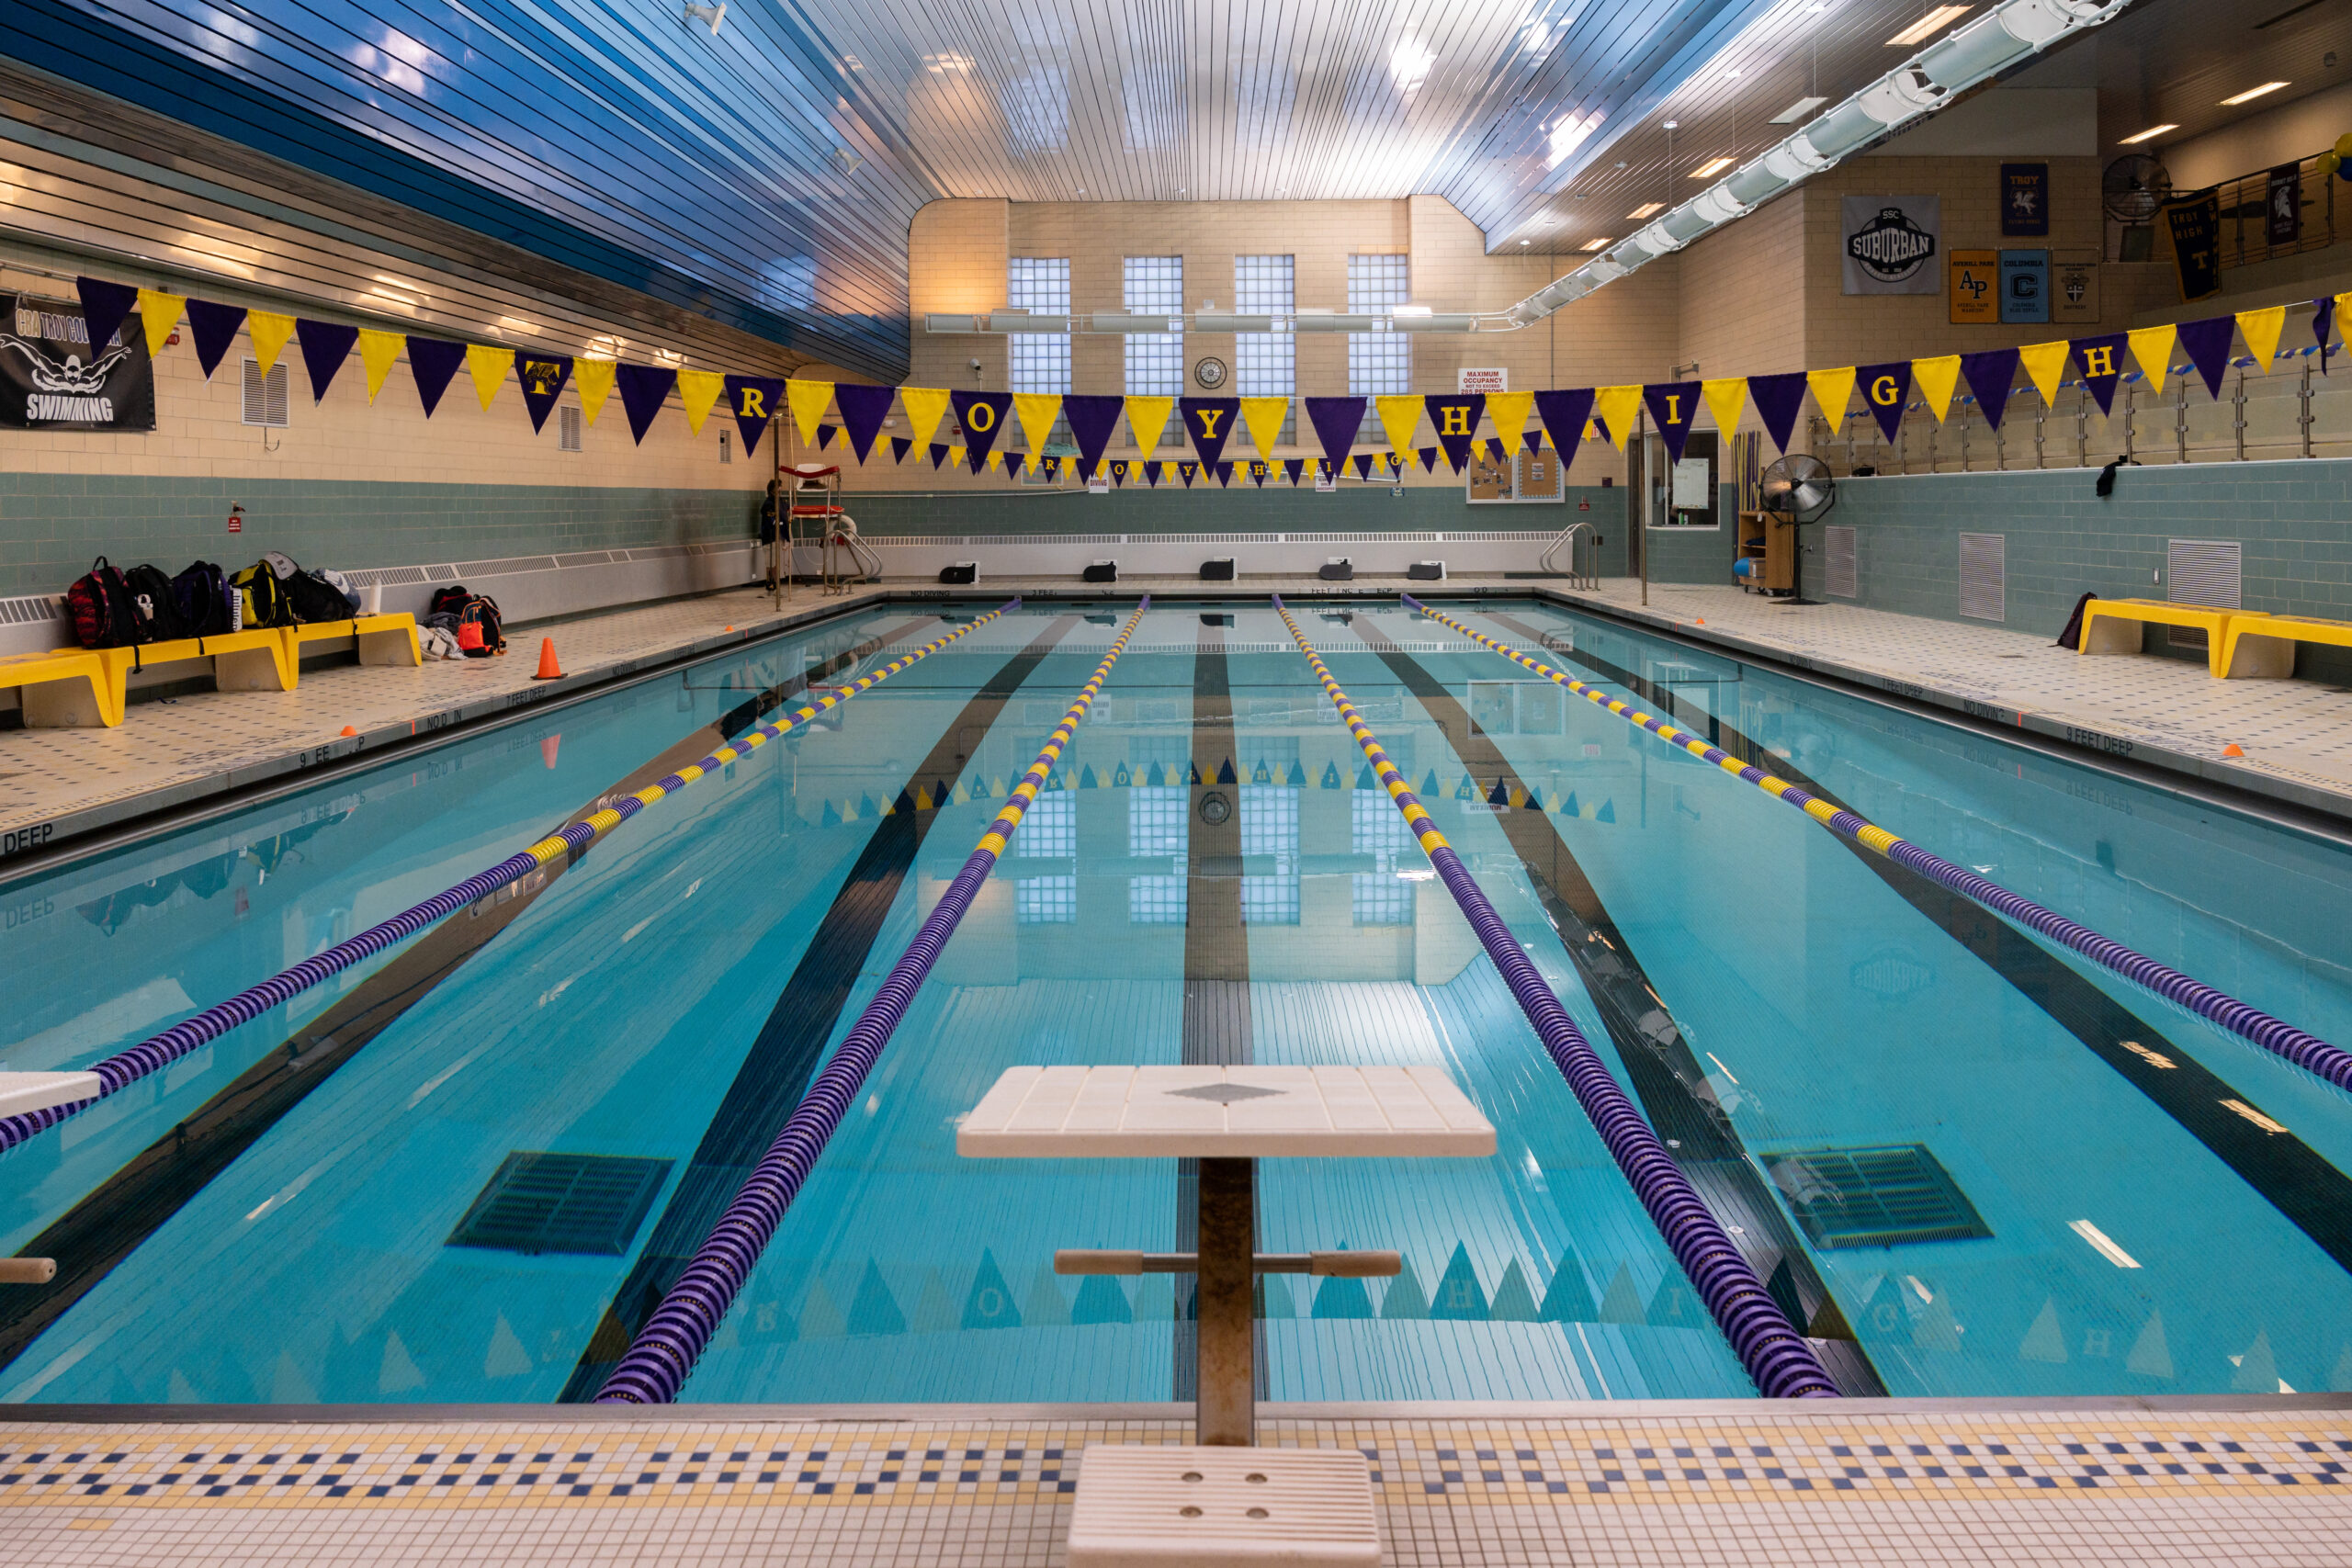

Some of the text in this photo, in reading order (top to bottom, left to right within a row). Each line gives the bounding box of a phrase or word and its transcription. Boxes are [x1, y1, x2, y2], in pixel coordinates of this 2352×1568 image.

[2009, 175, 2039, 185] TROY
[1883, 209, 1900, 220] SSC
[2172, 211, 2199, 225] TROY
[2175, 225, 2204, 241] HIGH
[1852, 227, 1930, 264] SUBURBAN
[2191, 249, 2210, 271] T
[2010, 273, 2038, 300] C
[16, 309, 123, 347] CBA TROY COLIA
[739, 387, 767, 419] R
[967, 402, 995, 433] O
[1196, 409, 1224, 439] Y
[1440, 406, 1472, 436] H
[1665, 395, 1682, 425] I
[1871, 376, 1899, 406] G
[2083, 345, 2117, 378] H
[27, 393, 114, 422] SWIMMING
[1963, 699, 1976, 715] NO
[427, 716, 439, 731] NO
[2066, 726, 2073, 743] 9
[2075, 728, 2102, 750] FEET
[2104, 735, 2133, 757] DEEP
[300, 753, 307, 768] 9
[5, 823, 53, 855] DEEP
